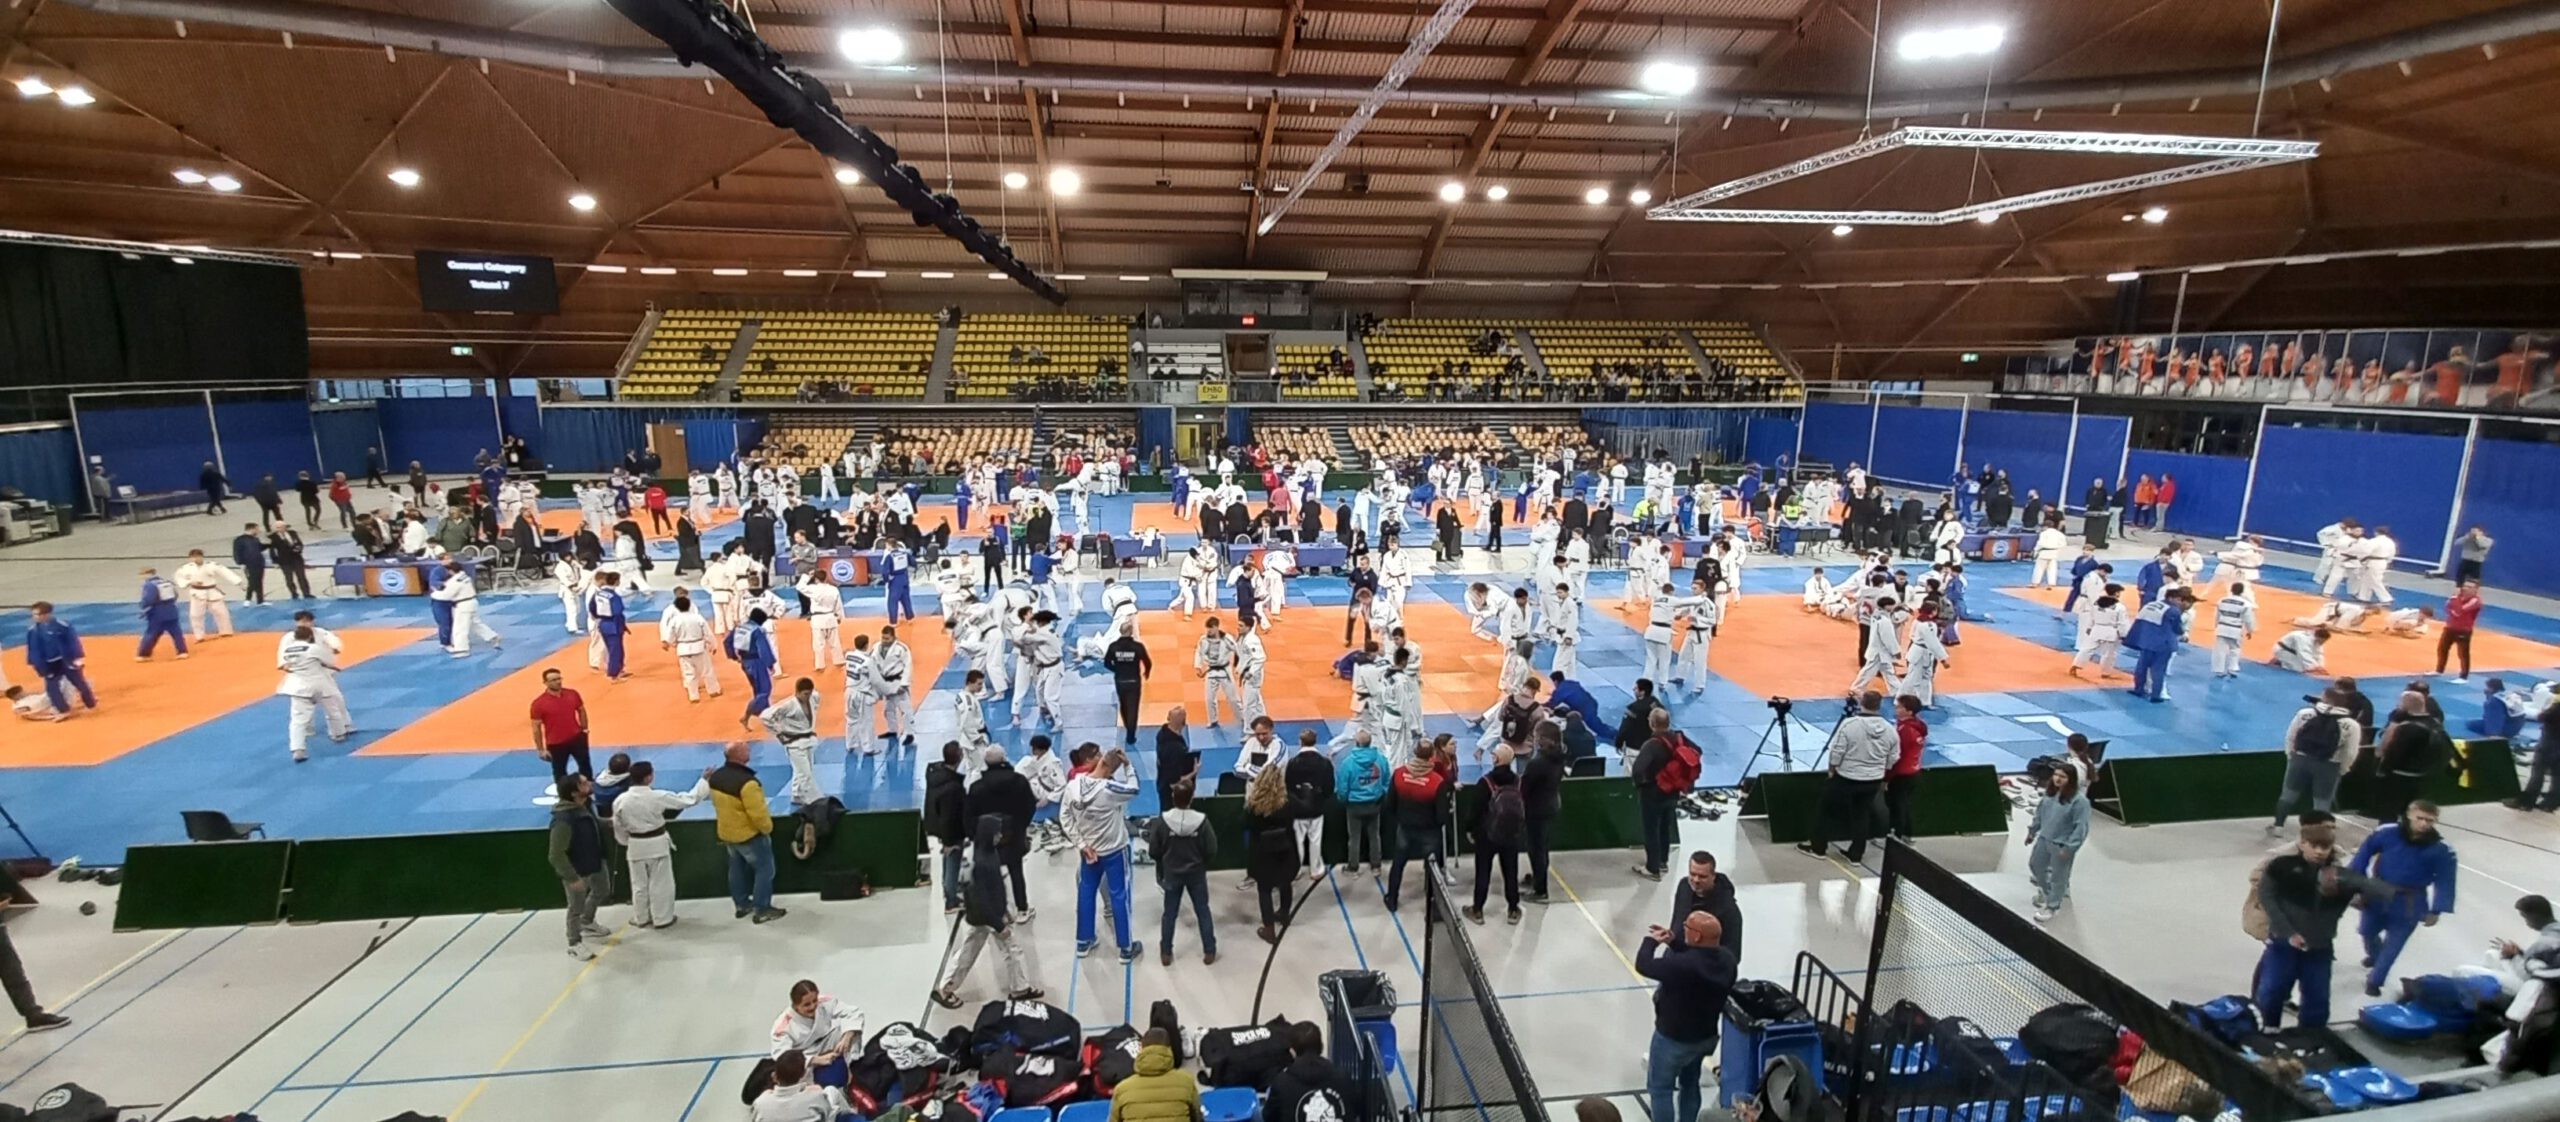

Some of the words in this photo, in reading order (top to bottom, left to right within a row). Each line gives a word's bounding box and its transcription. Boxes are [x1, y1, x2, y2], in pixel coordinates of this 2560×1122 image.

[447, 260, 483, 271] Current
[484, 262, 526, 274] Category
[469, 280, 501, 290] Tatami
[502, 281, 510, 290] 7
[1231, 1030, 1256, 1046] SUPER
